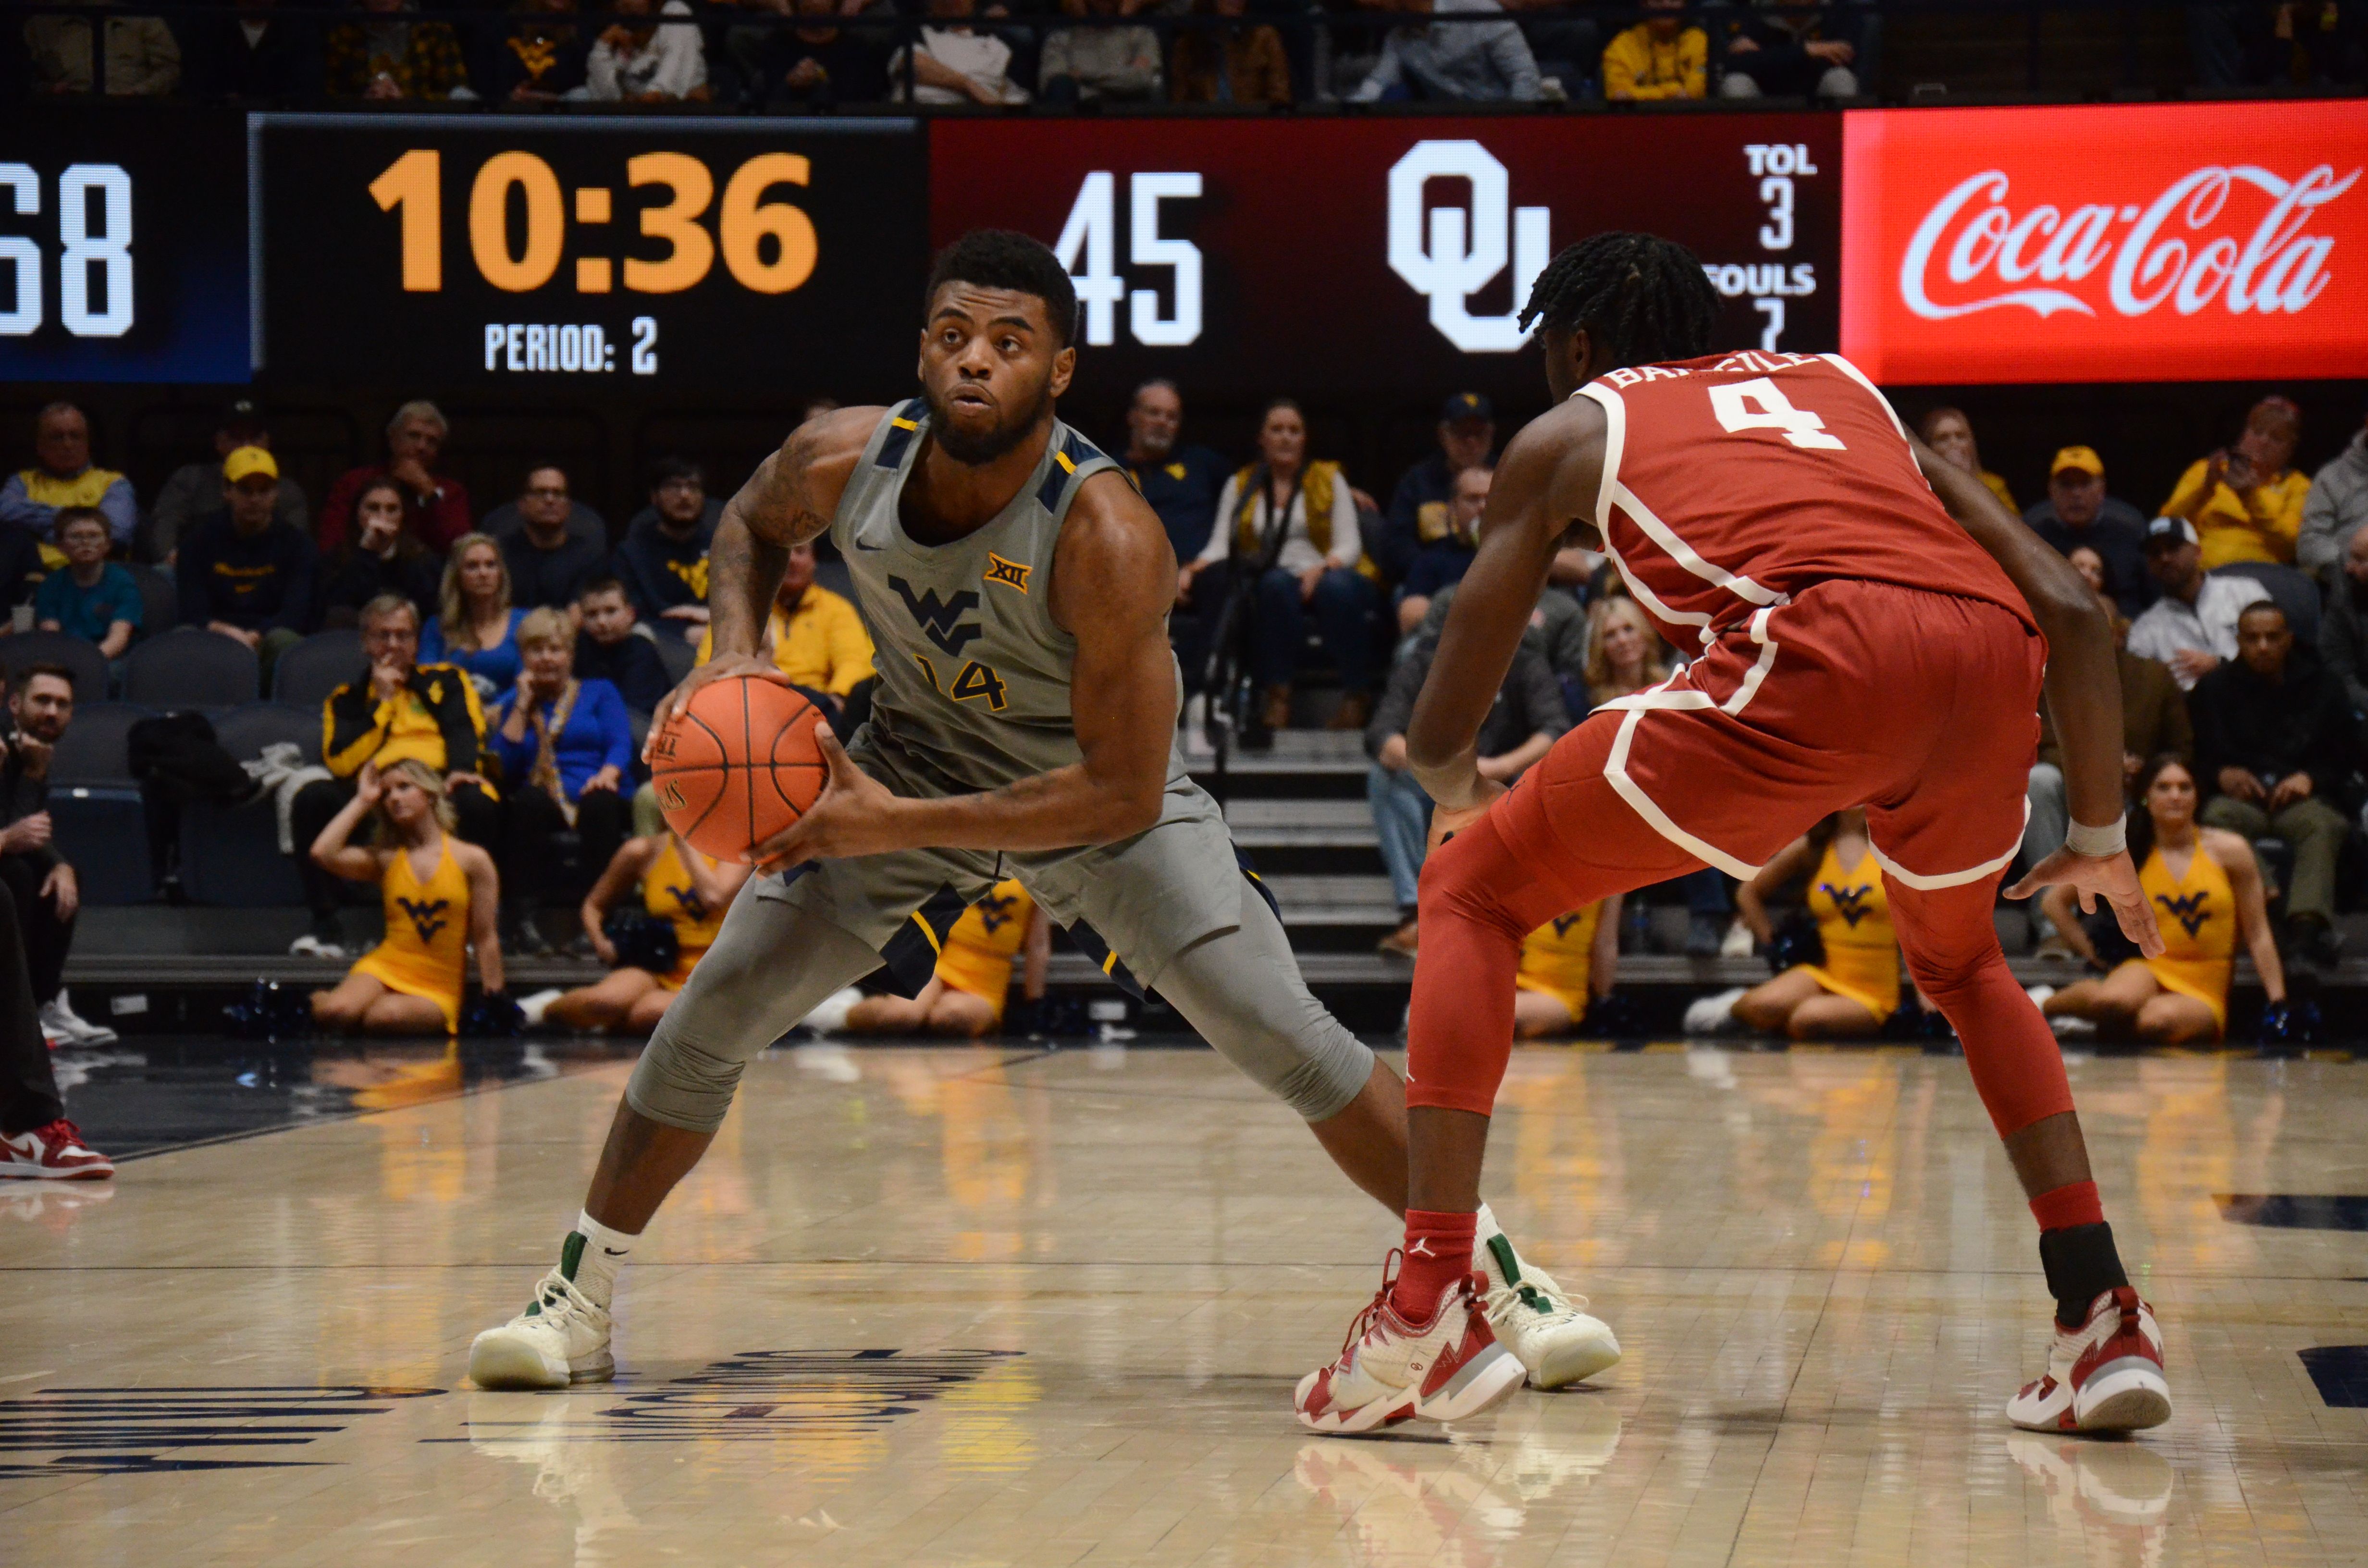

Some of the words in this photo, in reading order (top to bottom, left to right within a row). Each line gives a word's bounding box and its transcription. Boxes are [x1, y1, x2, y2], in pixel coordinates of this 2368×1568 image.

[1743, 144, 1818, 175] TOL
[369, 149, 818, 294] 10:36
[1387, 139, 1550, 353] OU
[1758, 177, 1795, 250] 3
[1899, 164, 2364, 320] Coca-Cola
[1055, 171, 1203, 346] 45
[485, 323, 615, 372] PERIOD:
[632, 316, 657, 375] 2
[1753, 298, 1785, 353] 7
[1708, 376, 1848, 450] 4
[985, 554, 1030, 591] XII
[913, 653, 1007, 712] 14
